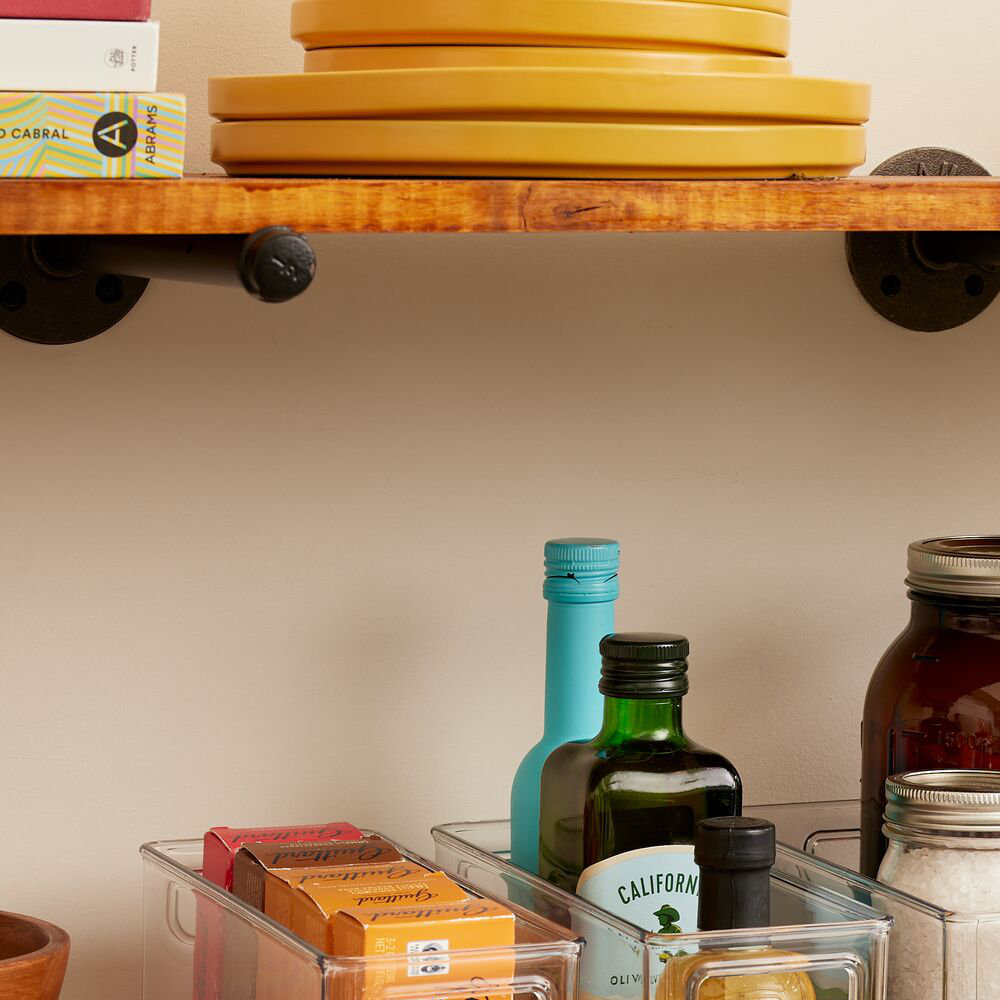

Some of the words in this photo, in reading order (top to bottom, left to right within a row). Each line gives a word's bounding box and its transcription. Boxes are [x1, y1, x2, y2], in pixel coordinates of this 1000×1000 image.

[11, 128, 69, 139] CABRAL
[145, 104, 158, 165] ABRAMS
[269, 843, 393, 865] Guittard
[300, 865, 420, 884] Guittard
[357, 889, 439, 906] Guittard
[617, 872, 699, 904] CALIFORN
[370, 903, 498, 922] Guittard
